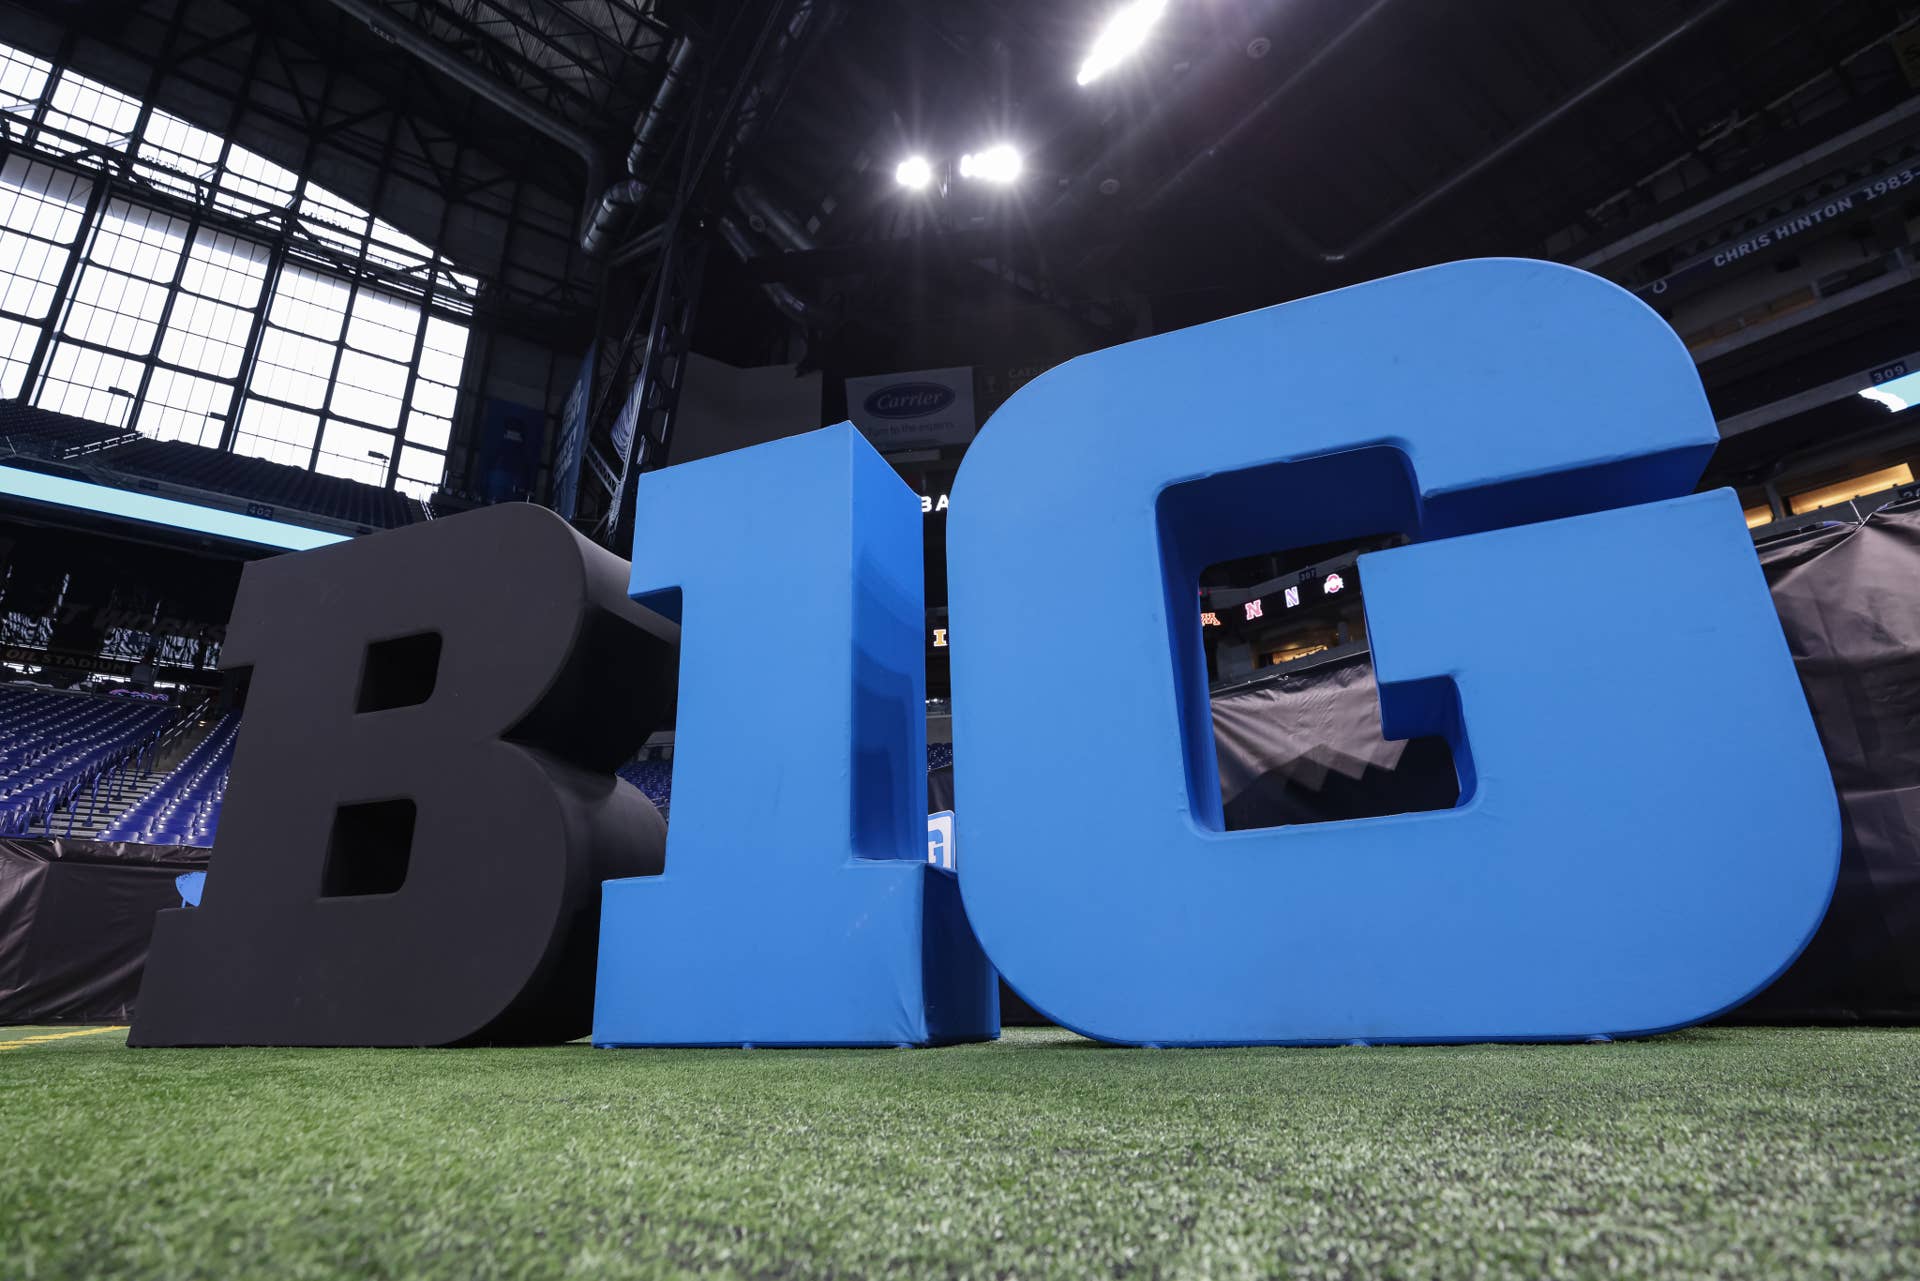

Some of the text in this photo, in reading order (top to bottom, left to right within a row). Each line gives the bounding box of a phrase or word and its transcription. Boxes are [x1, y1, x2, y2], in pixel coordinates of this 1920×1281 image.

[1713, 234, 1771, 267] CHRIS
[1774, 197, 1853, 240] HINTON
[1873, 364, 1905, 383] 309
[876, 390, 944, 411] Carrier
[248, 504, 272, 518] 402
[1284, 586, 1300, 608] N
[1244, 599, 1263, 621] N
[41, 654, 128, 674] STADIUM
